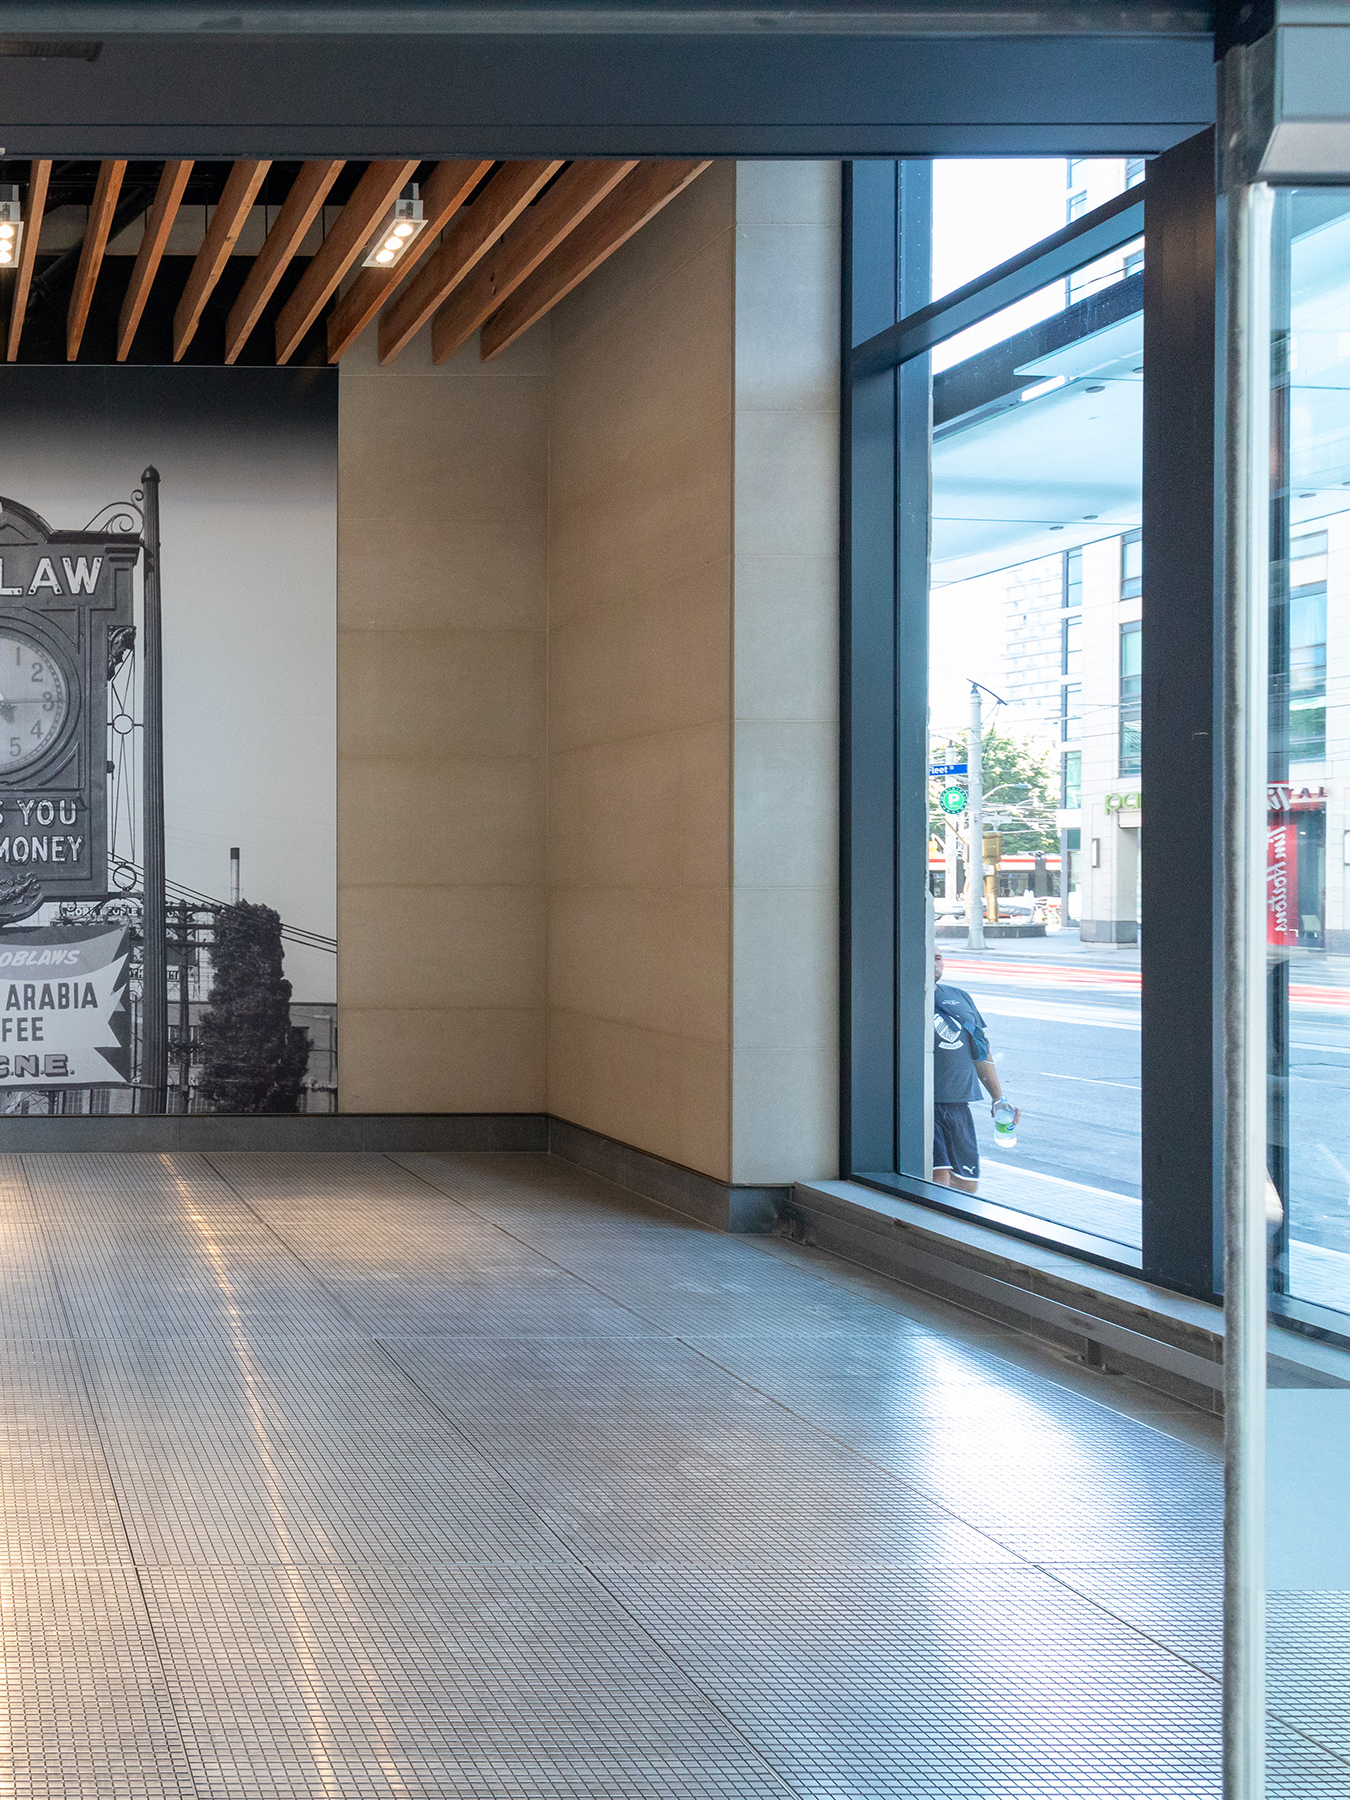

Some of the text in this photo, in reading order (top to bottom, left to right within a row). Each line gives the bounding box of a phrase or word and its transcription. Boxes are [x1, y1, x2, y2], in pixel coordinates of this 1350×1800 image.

[31, 662, 43, 683] 2
[42, 691, 55, 711] 3
[30, 719, 43, 740] 4
[10, 737, 22, 757] 5
[948, 793, 960, 805] P
[17, 799, 77, 827] YOU
[5, 982, 98, 1011] ARABIA
